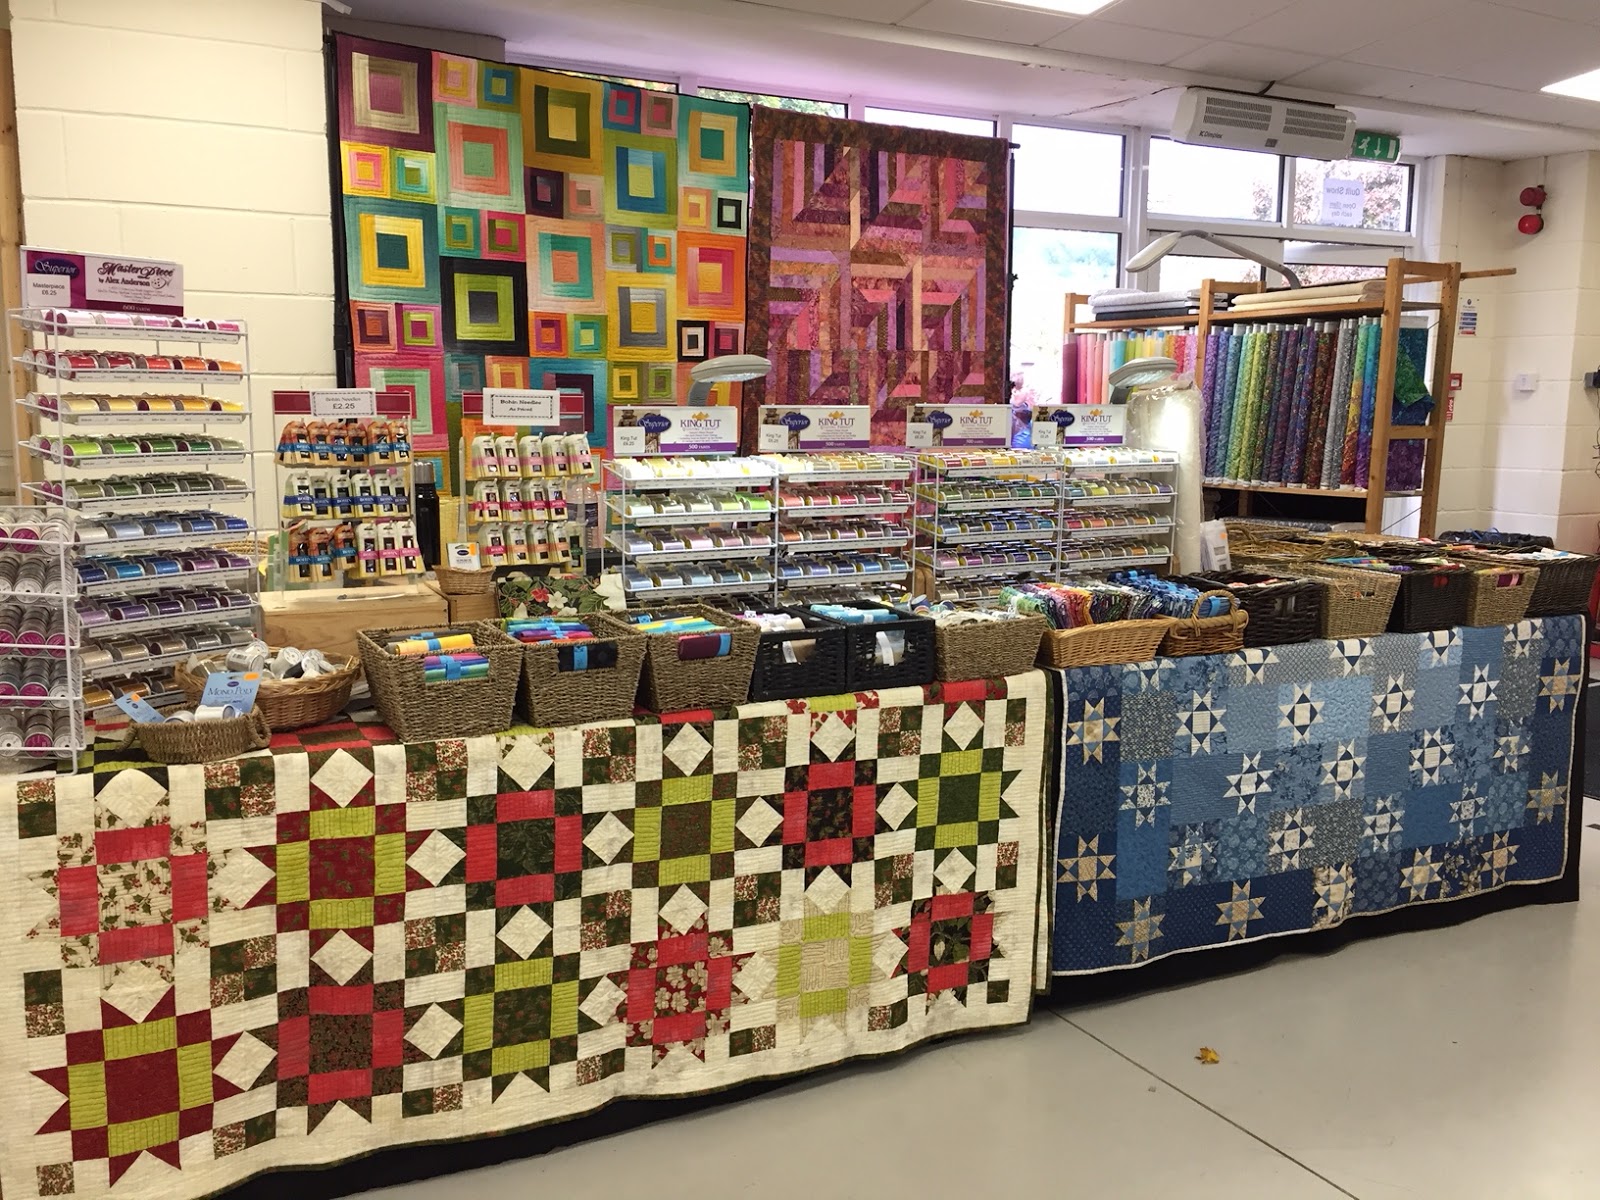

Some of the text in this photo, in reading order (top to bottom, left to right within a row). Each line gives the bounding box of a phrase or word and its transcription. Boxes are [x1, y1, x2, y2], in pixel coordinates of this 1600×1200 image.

[34, 260, 77, 276] Superior
[105, 276, 120, 284] Alex
[121, 277, 150, 287] Anderson
[32, 282, 66, 290] Masterpiece
[680, 418, 722, 428] KING TUT
[818, 418, 856, 426] KING TUT
[960, 416, 993, 424] KING TUT
[1080, 415, 1112, 423] KING TUT
